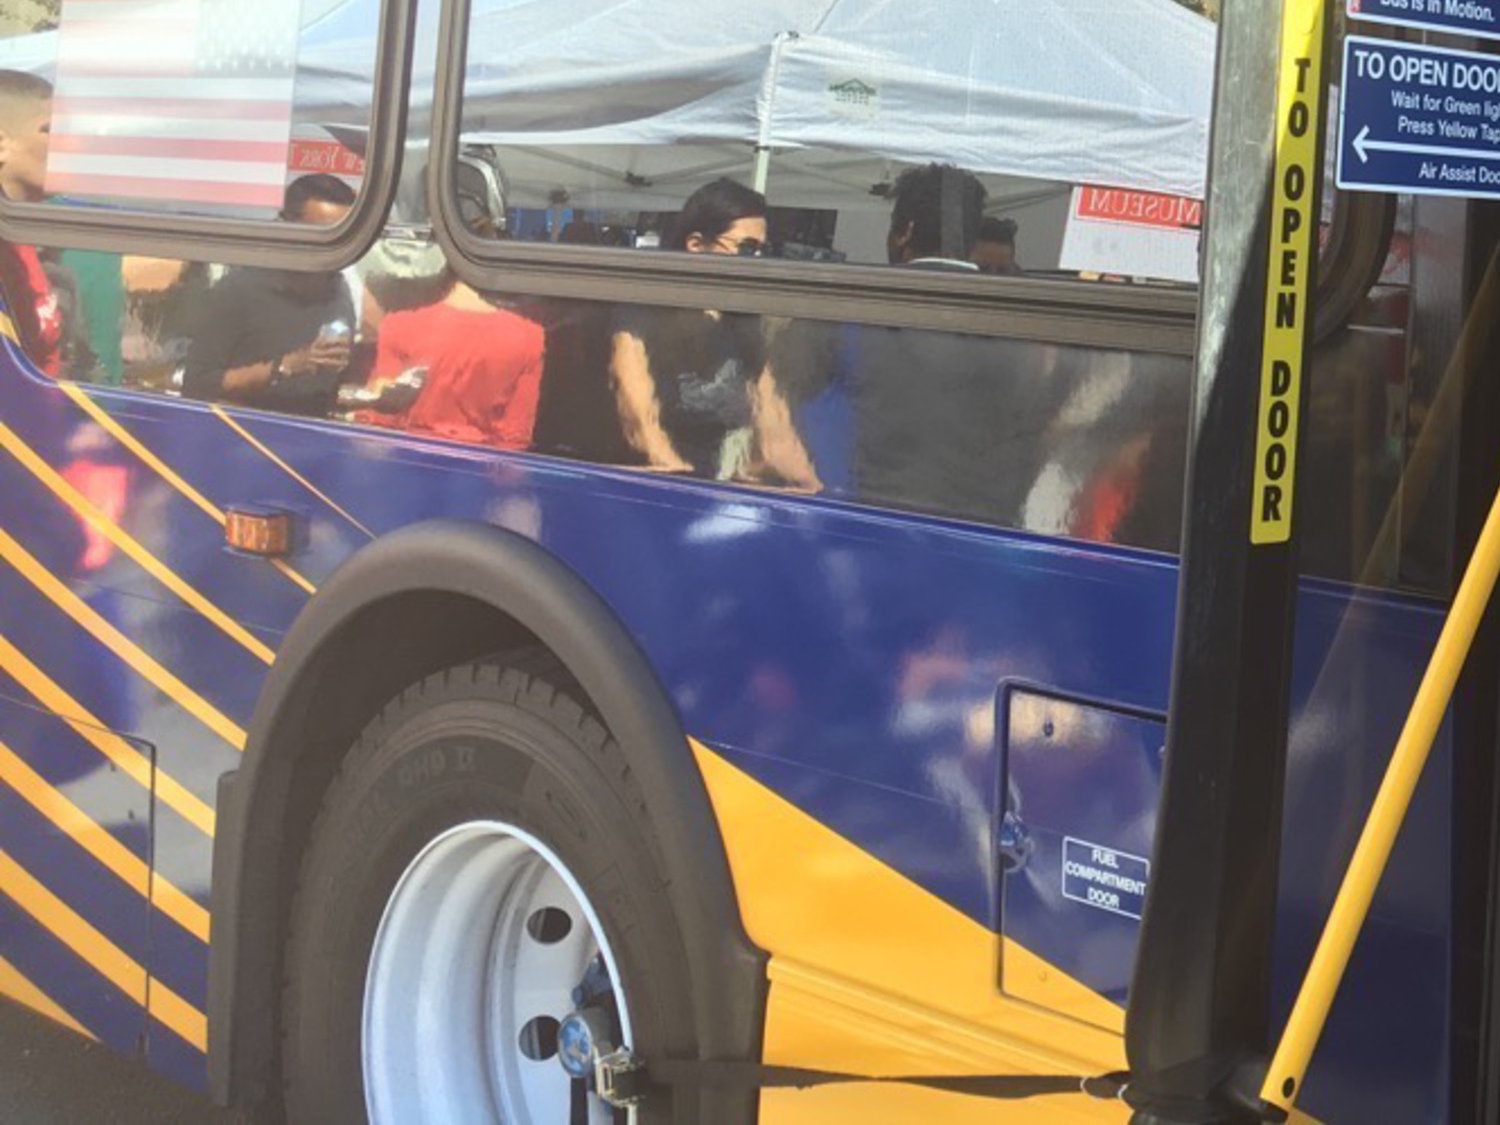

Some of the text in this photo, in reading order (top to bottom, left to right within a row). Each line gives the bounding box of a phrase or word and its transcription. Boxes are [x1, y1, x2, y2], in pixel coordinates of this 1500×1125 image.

[1354, 50, 1385, 79] TO
[1389, 55, 1449, 87] OPEN
[1287, 57, 1312, 139] TO
[1391, 90, 1420, 110] Wait
[1423, 94, 1442, 111] for
[1444, 96, 1480, 116] Green
[1397, 116, 1435, 136] Press
[1438, 119, 1478, 139] Yellow
[1419, 162, 1438, 179] Air
[1439, 163, 1477, 183] Assist
[1274, 164, 1305, 330] OPEN
[1261, 359, 1293, 524] DOOR
[1091, 848, 1119, 869] FUEL
[1065, 860, 1146, 896] COMPARTMENT
[1087, 886, 1119, 908] DOOR
